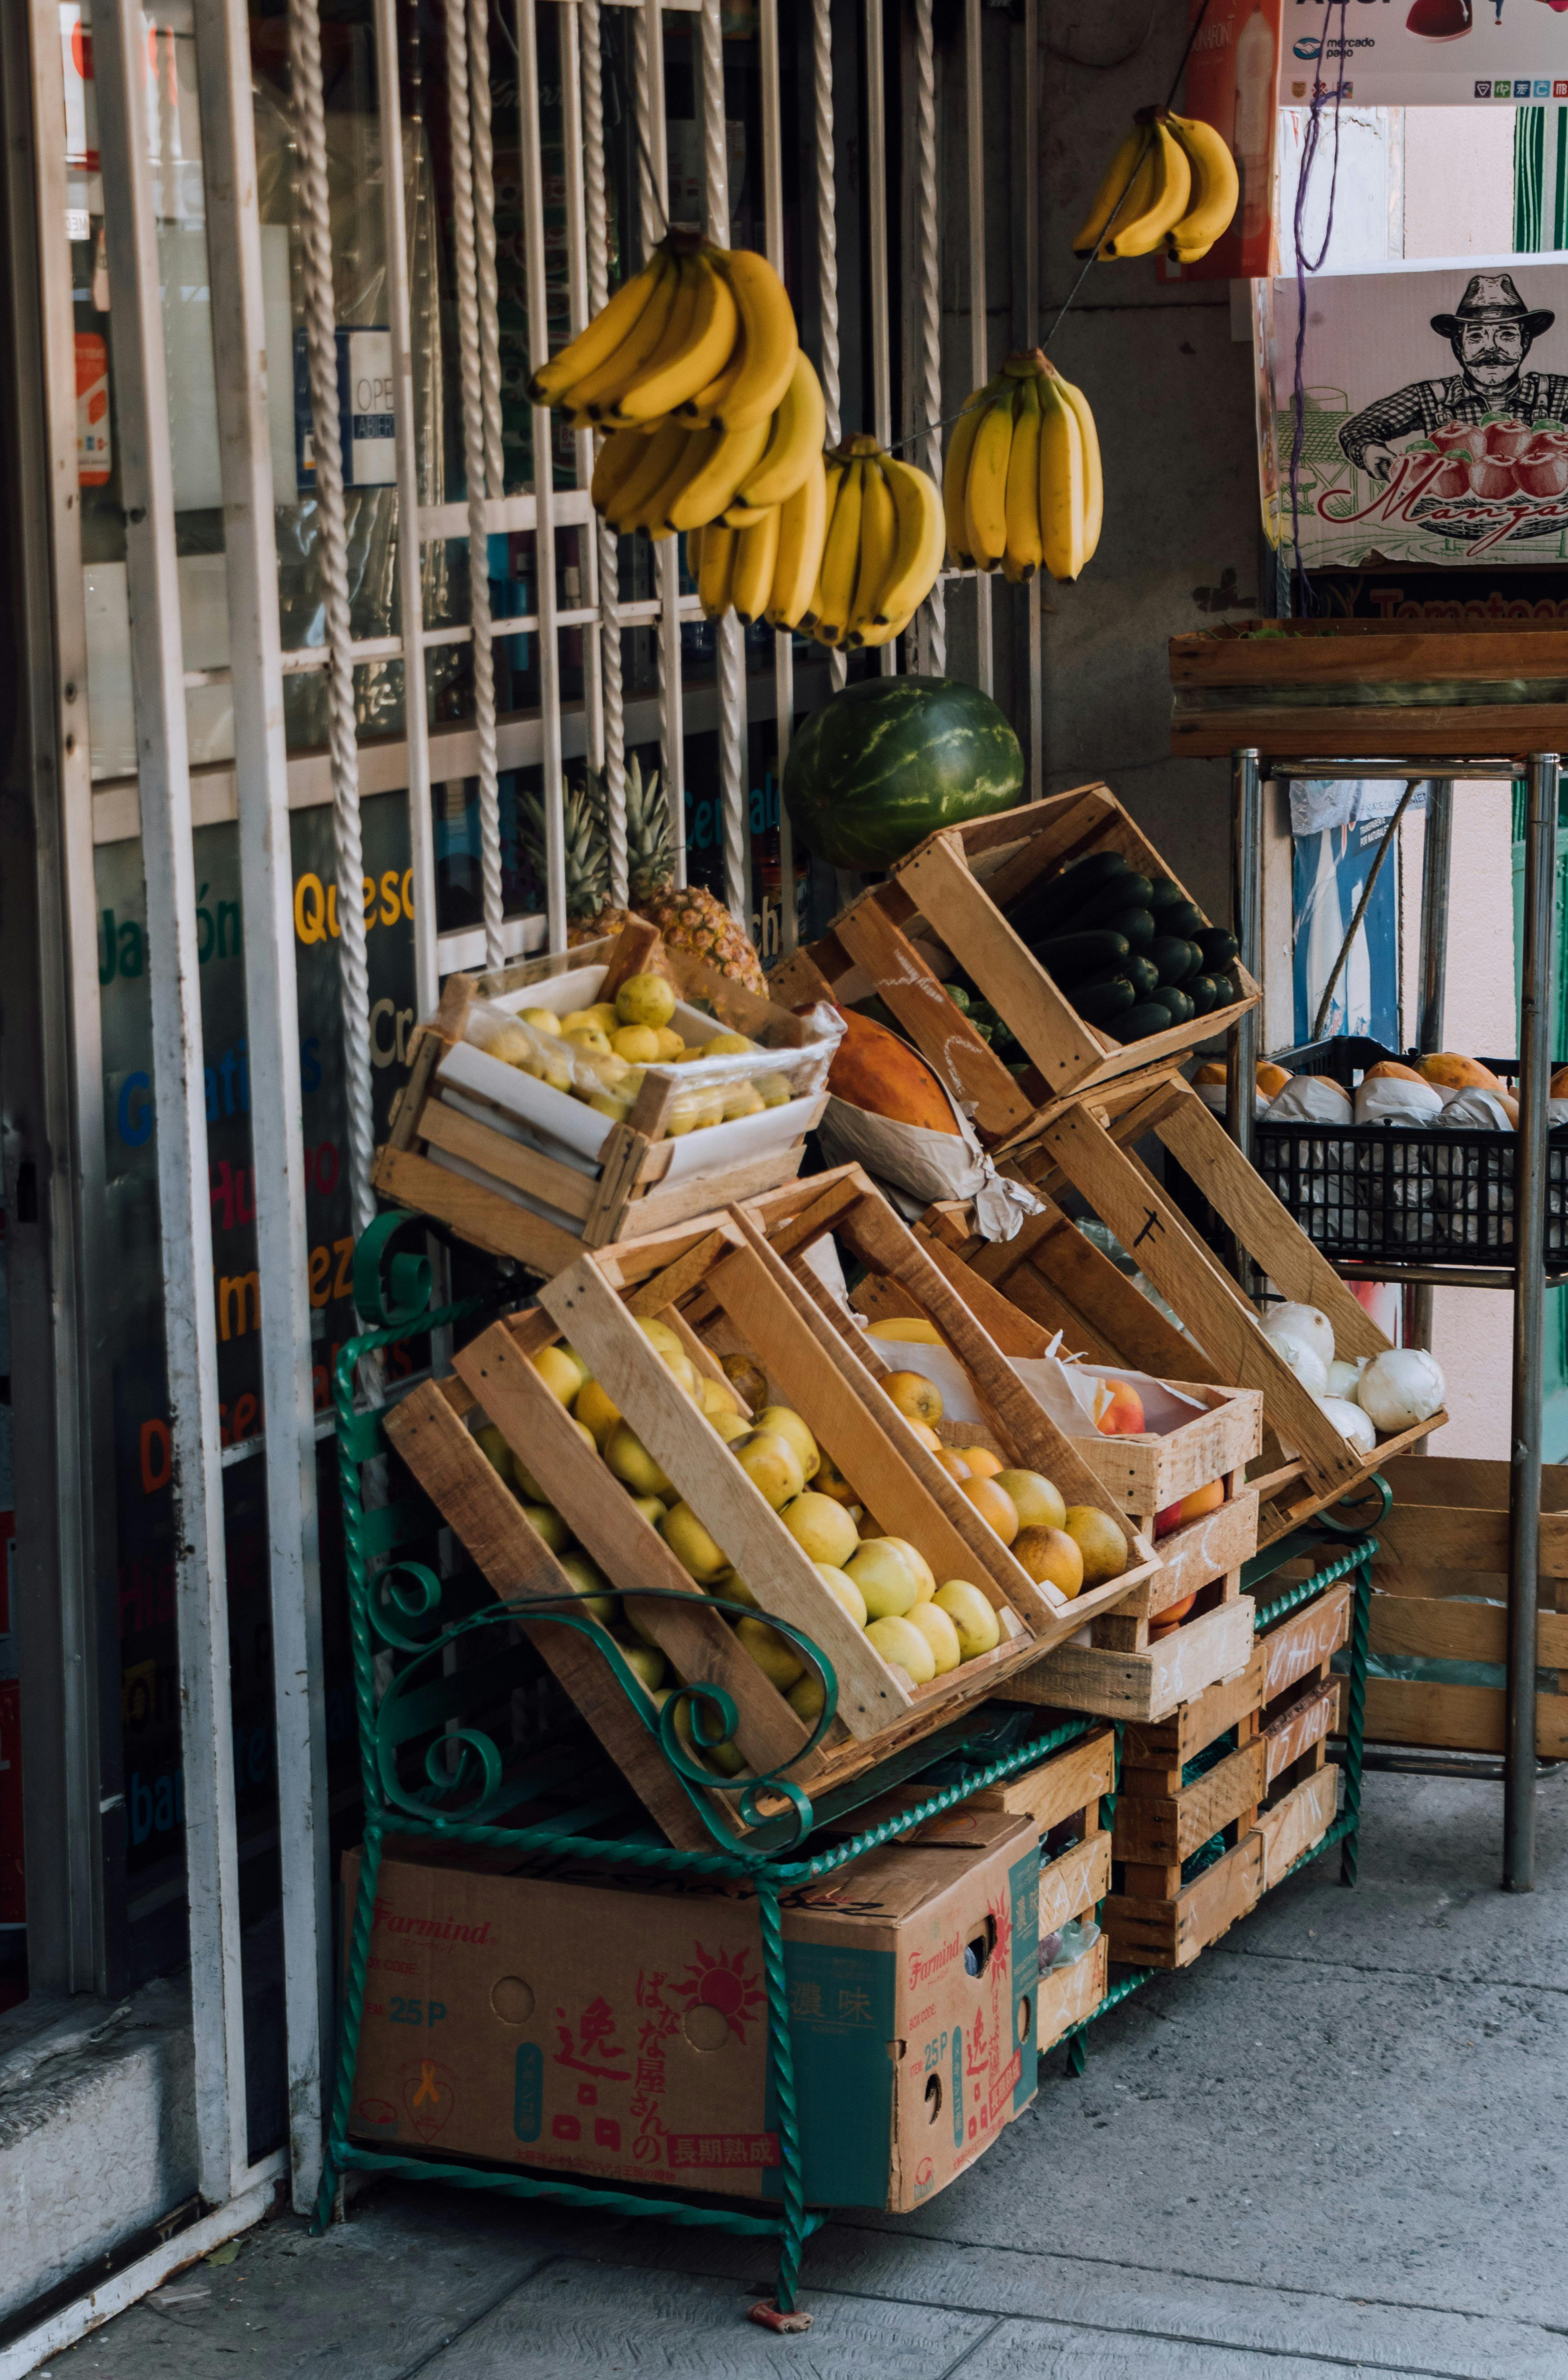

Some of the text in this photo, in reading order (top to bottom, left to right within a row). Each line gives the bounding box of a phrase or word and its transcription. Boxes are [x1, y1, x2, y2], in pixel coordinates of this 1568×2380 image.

[1327, 37, 1375, 48] mercado
[358, 378, 394, 411] OPE
[99, 883, 240, 985] Jaón
[372, 1897, 491, 1944] Farmind
[909, 1931, 959, 1991] Farmind
[673, 2138, 775, 2163] 長期熟成
